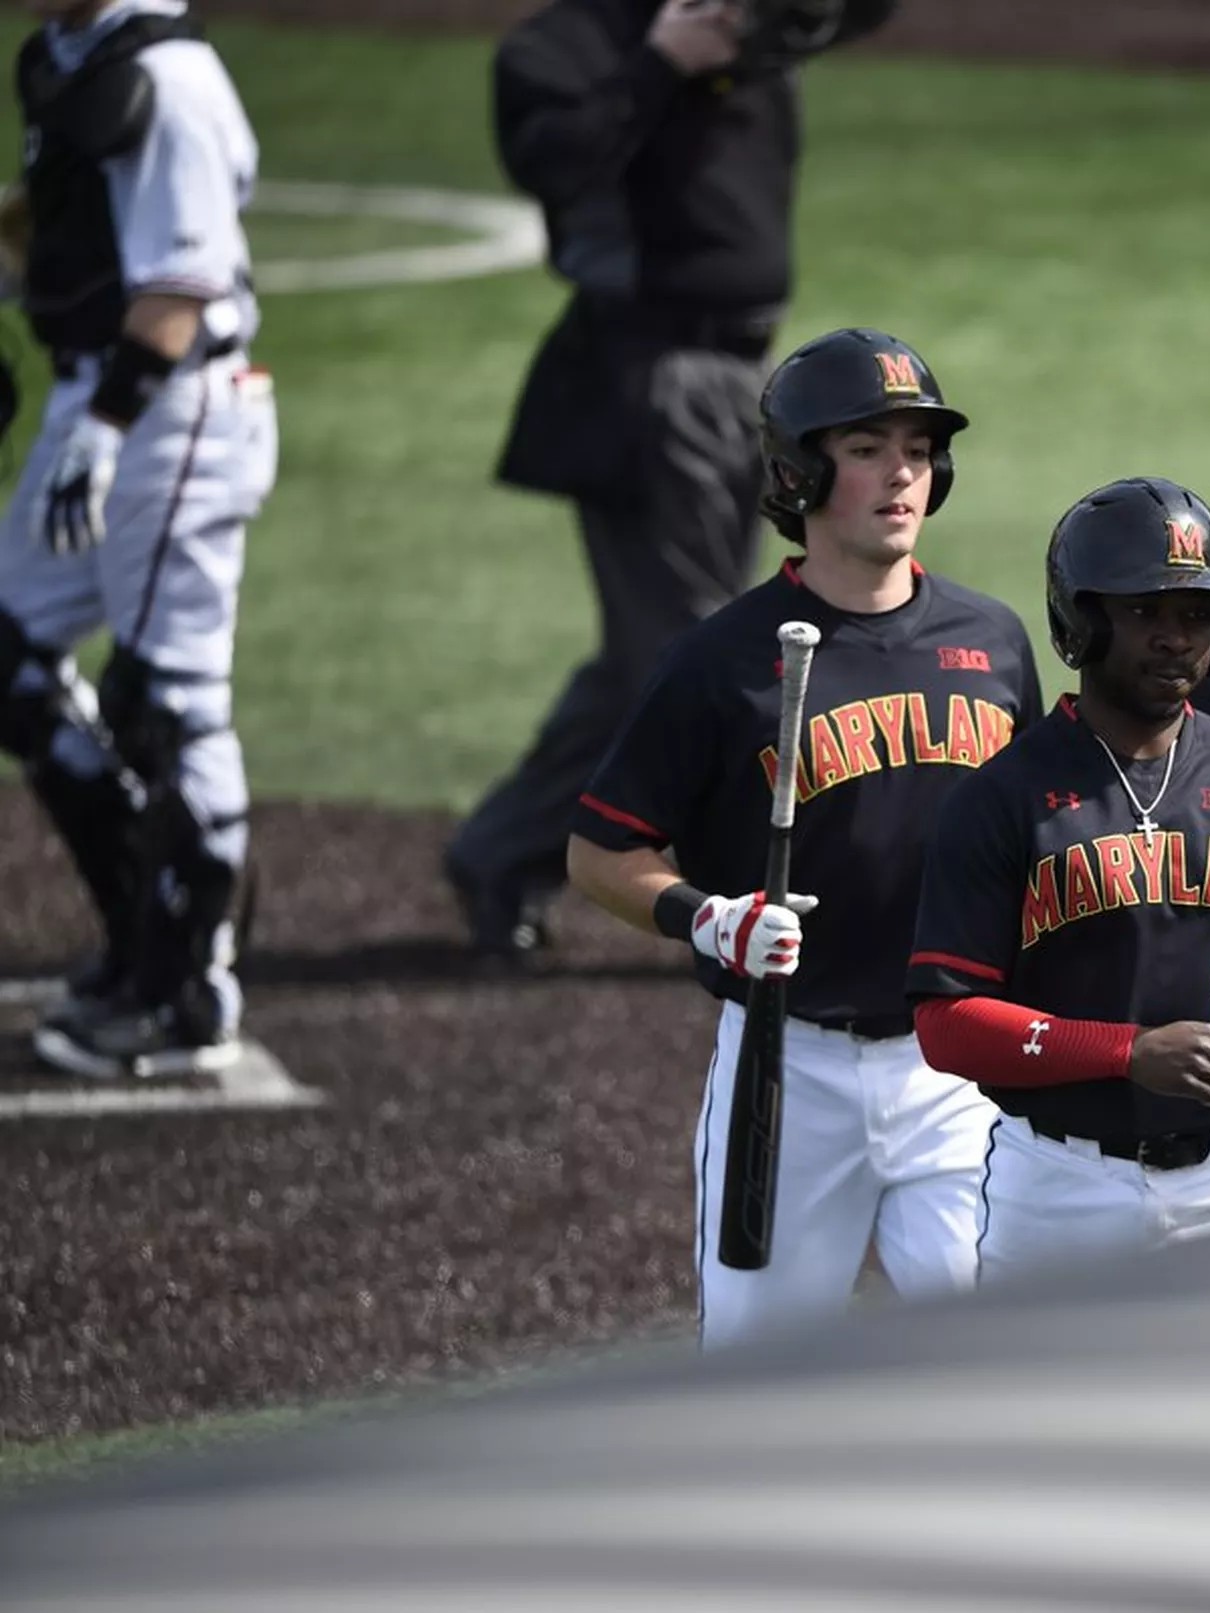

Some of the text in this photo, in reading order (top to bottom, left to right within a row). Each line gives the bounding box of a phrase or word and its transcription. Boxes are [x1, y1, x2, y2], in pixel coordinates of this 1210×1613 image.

[874, 353, 920, 392] M
[1165, 520, 1206, 566] M
[758, 693, 1014, 804] MARYLAN
